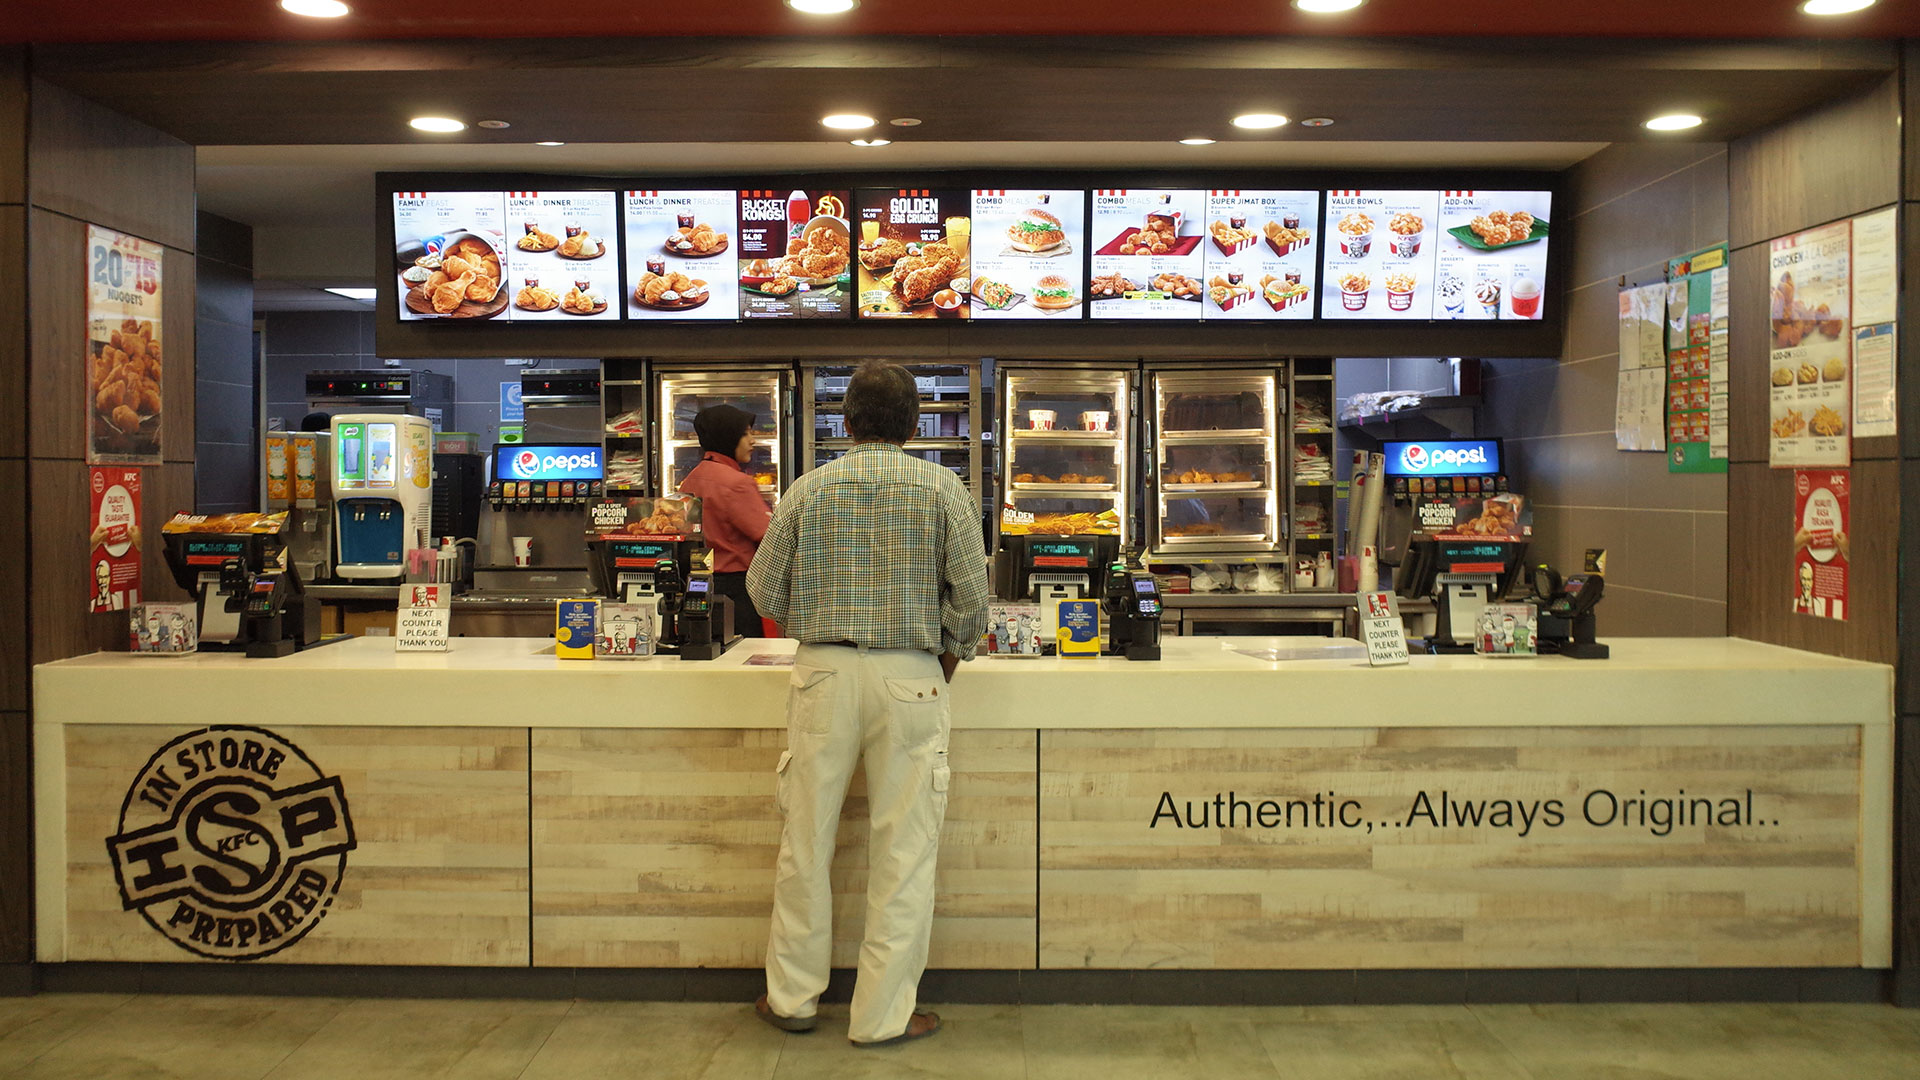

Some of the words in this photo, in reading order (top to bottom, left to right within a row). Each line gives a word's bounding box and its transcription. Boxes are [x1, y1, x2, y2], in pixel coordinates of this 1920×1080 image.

[741, 199, 786, 210] BUCKET
[890, 198, 939, 214] GOLDEN
[742, 209, 786, 221] KONGSI
[890, 213, 906, 224] EGG
[907, 213, 939, 224] CRUNCH
[1773, 252, 1803, 269] CHICKEN
[94, 245, 122, 288] 20
[135, 255, 157, 295] 15
[108, 288, 143, 306] NUGGETS
[542, 451, 598, 472] pepsi
[1431, 446, 1487, 468] pepsi
[124, 472, 137, 482] KFC
[1831, 474, 1846, 486] KFC
[174, 513, 208, 522] GOLDEN
[592, 507, 628, 517] POPCORN
[1003, 507, 1035, 521] GOLDEN
[1419, 507, 1456, 518] POPCORN
[594, 516, 625, 525] CHICKEN
[1422, 517, 1454, 526] CHICKEN
[1373, 620, 1391, 628] NEXT
[406, 629, 439, 637] PLEASE
[1368, 630, 1400, 639] COUNTER
[1374, 640, 1399, 649] PLEASE
[1371, 651, 1392, 660] THANK
[1394, 650, 1408, 659] YOU
[140, 765, 181, 813] IN
[176, 737, 286, 781] STORE
[216, 831, 260, 855] KFC
[166, 868, 328, 948] PREPARED
